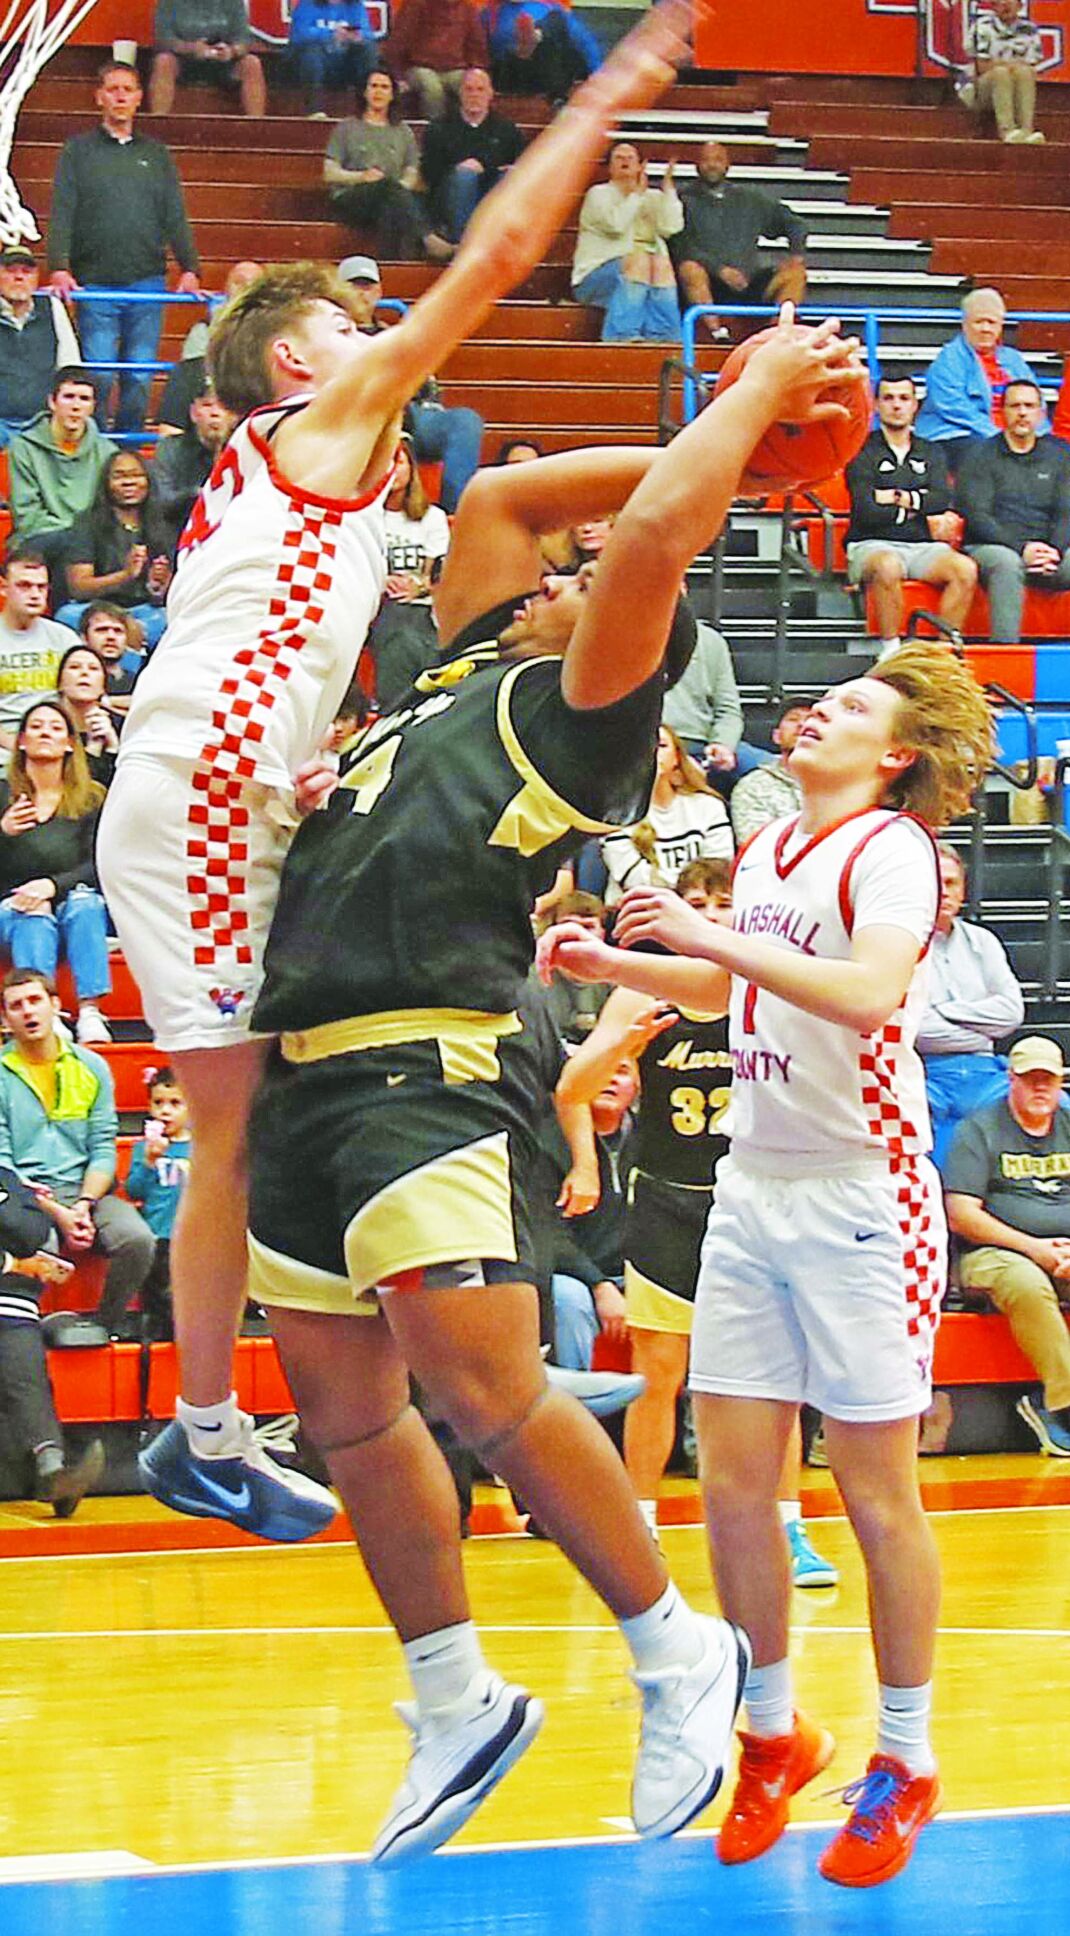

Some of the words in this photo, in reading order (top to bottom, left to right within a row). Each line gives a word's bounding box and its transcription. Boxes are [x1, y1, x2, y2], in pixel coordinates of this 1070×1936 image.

[318, 733, 403, 814] 4
[731, 1049, 791, 1082] OUNTY
[670, 1087, 734, 1136] 32
